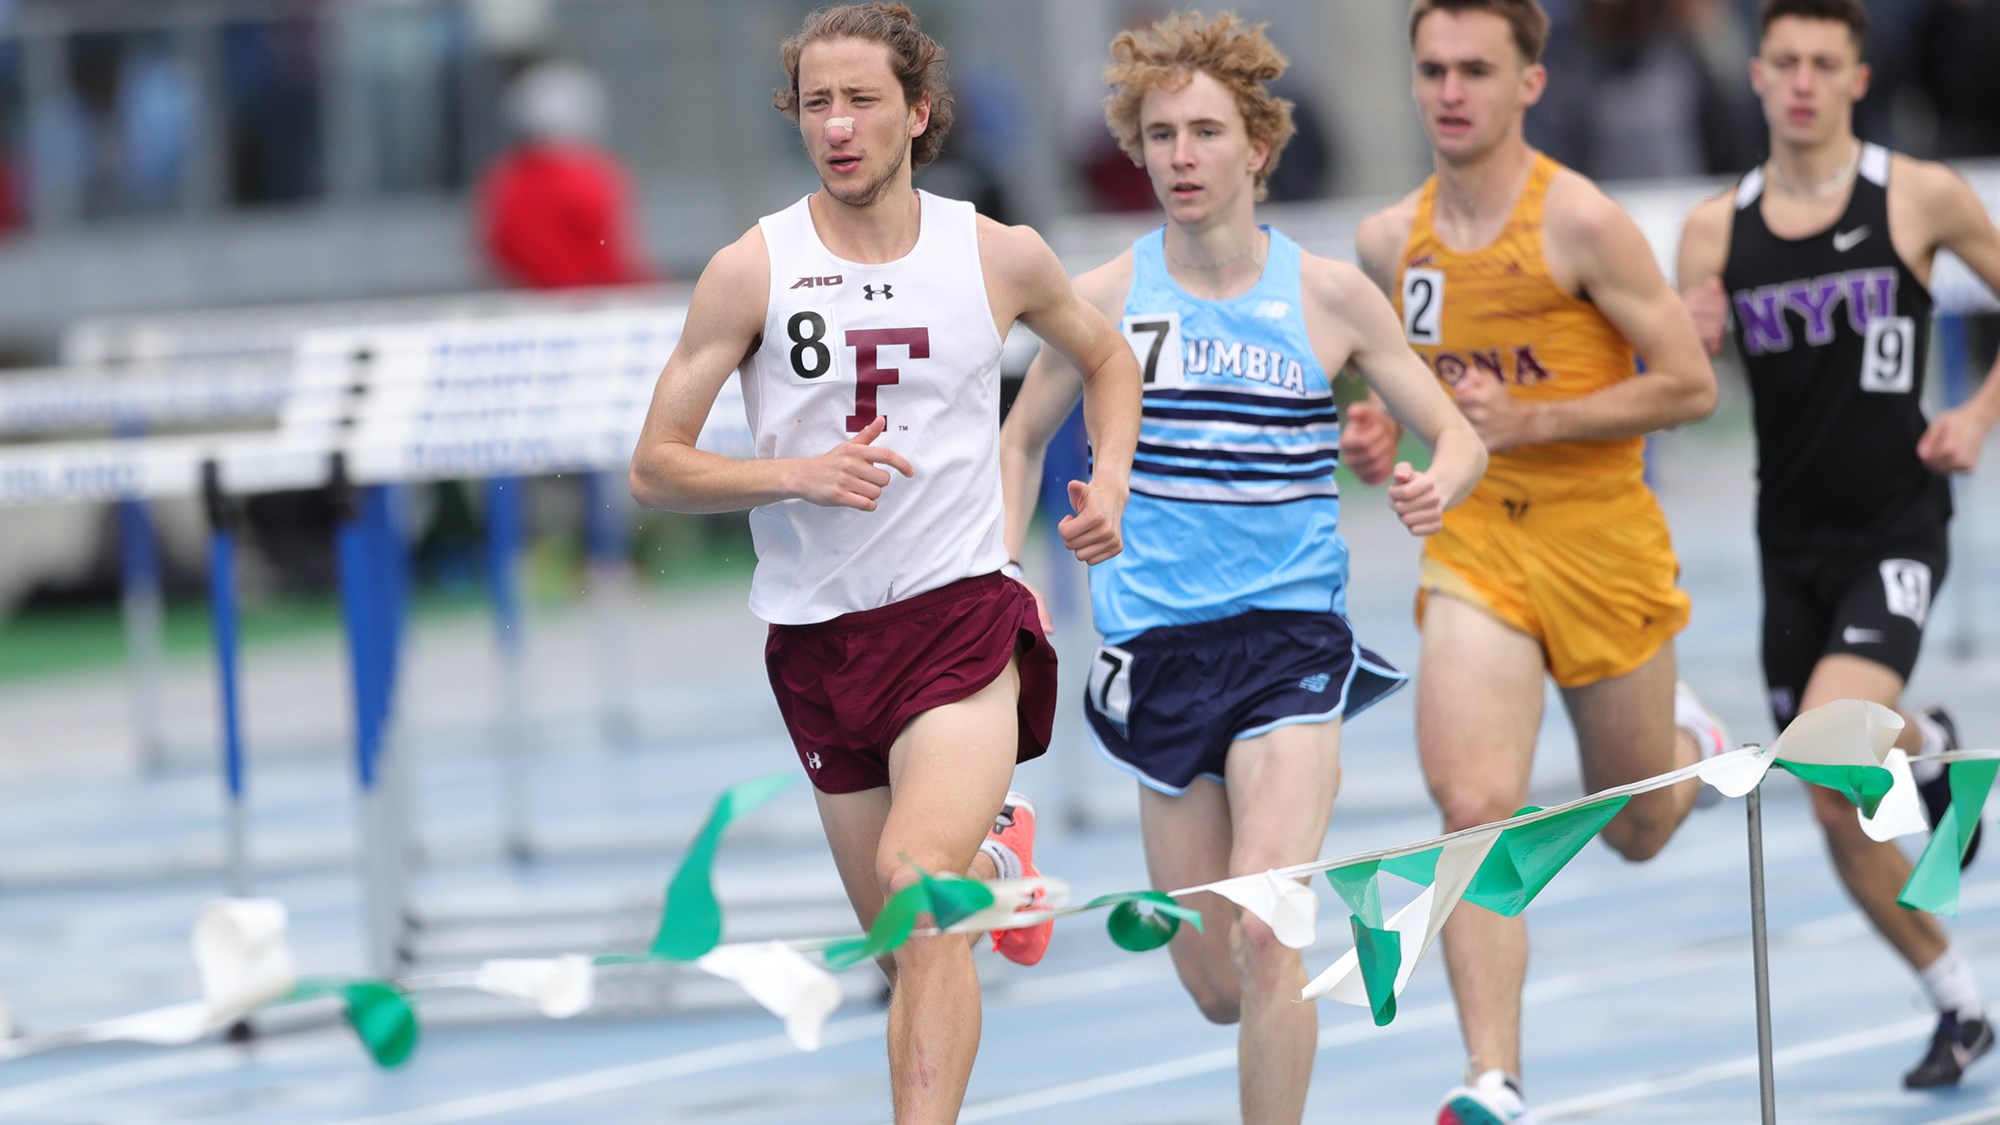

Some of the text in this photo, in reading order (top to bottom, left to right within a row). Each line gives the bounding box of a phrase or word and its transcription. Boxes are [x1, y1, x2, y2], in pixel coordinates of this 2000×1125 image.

[789, 275, 843, 289] A10
[1411, 279, 1432, 336] 2
[1735, 267, 1898, 355] NYU
[787, 311, 831, 379] 8
[1132, 321, 1170, 384] 7
[1183, 339, 1306, 397] UMBIA
[1420, 346, 1550, 386] ONA
[1875, 330, 1902, 381] 9
[845, 327, 930, 432] F
[1100, 651, 1122, 710] 7
